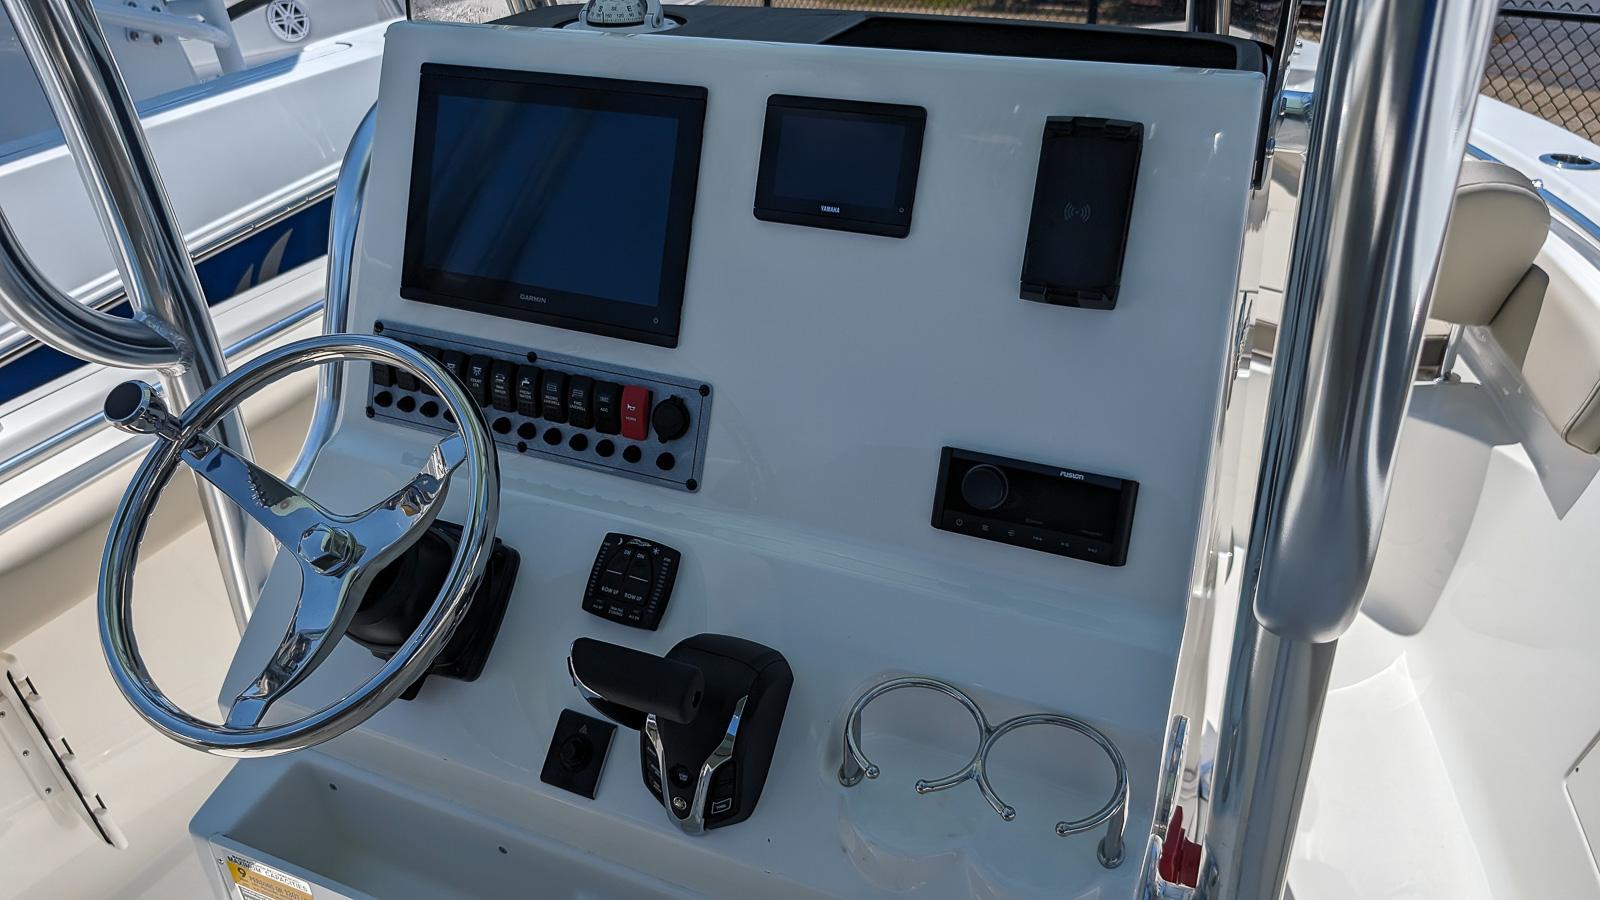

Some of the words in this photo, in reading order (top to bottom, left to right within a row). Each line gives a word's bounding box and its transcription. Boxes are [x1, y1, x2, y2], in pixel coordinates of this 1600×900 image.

[820, 204, 840, 214] YAMAHA
[519, 293, 547, 304] GARMIN
[238, 867, 247, 877] 9
